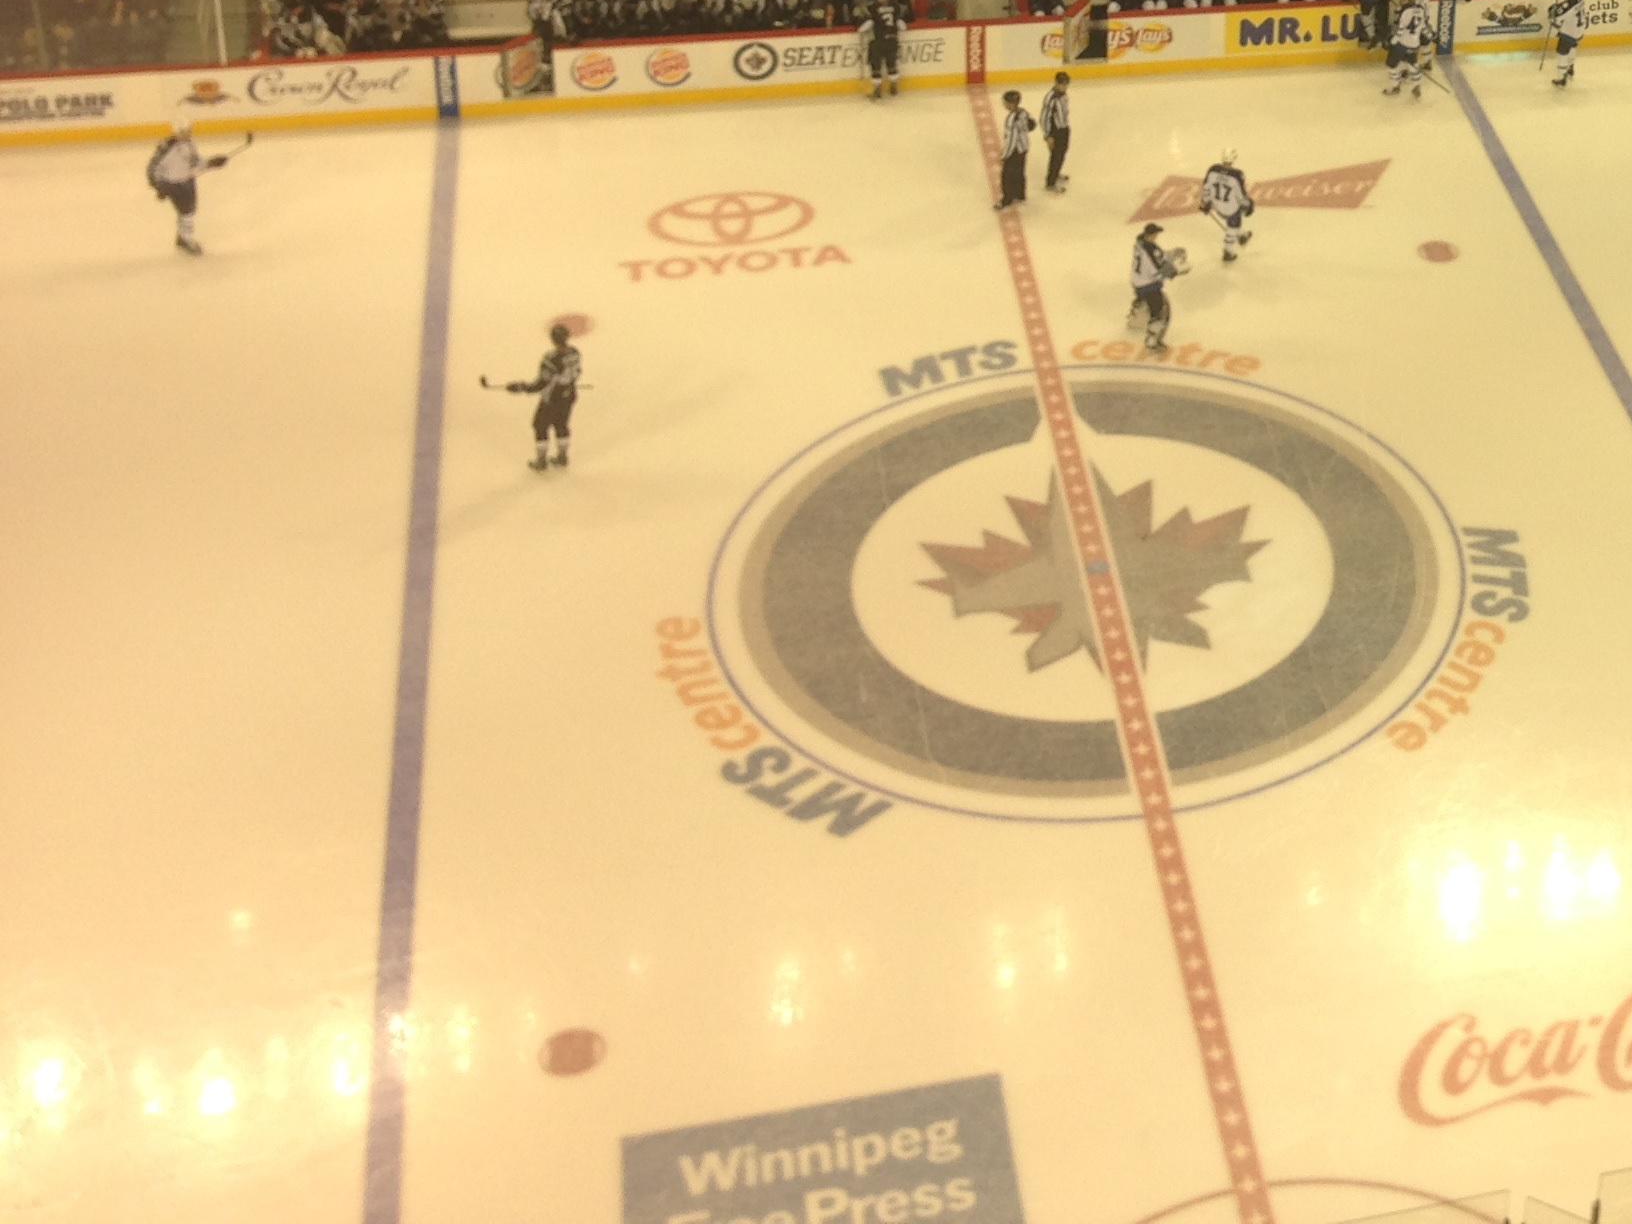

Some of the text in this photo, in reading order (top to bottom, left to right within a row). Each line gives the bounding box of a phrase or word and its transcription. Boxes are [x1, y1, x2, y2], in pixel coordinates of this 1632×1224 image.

[1589, 0, 1619, 12] club
[1239, 14, 1362, 47] MR. LU
[1213, 181, 1233, 203] 17
[618, 244, 852, 282] TOYOTA
[879, 339, 1017, 396] MTS
[1386, 526, 1530, 752] MTS centre
[655, 616, 893, 838] MTS centre
[677, 1119, 963, 1196] Winnipeg
[804, 1176, 978, 1224] Press
